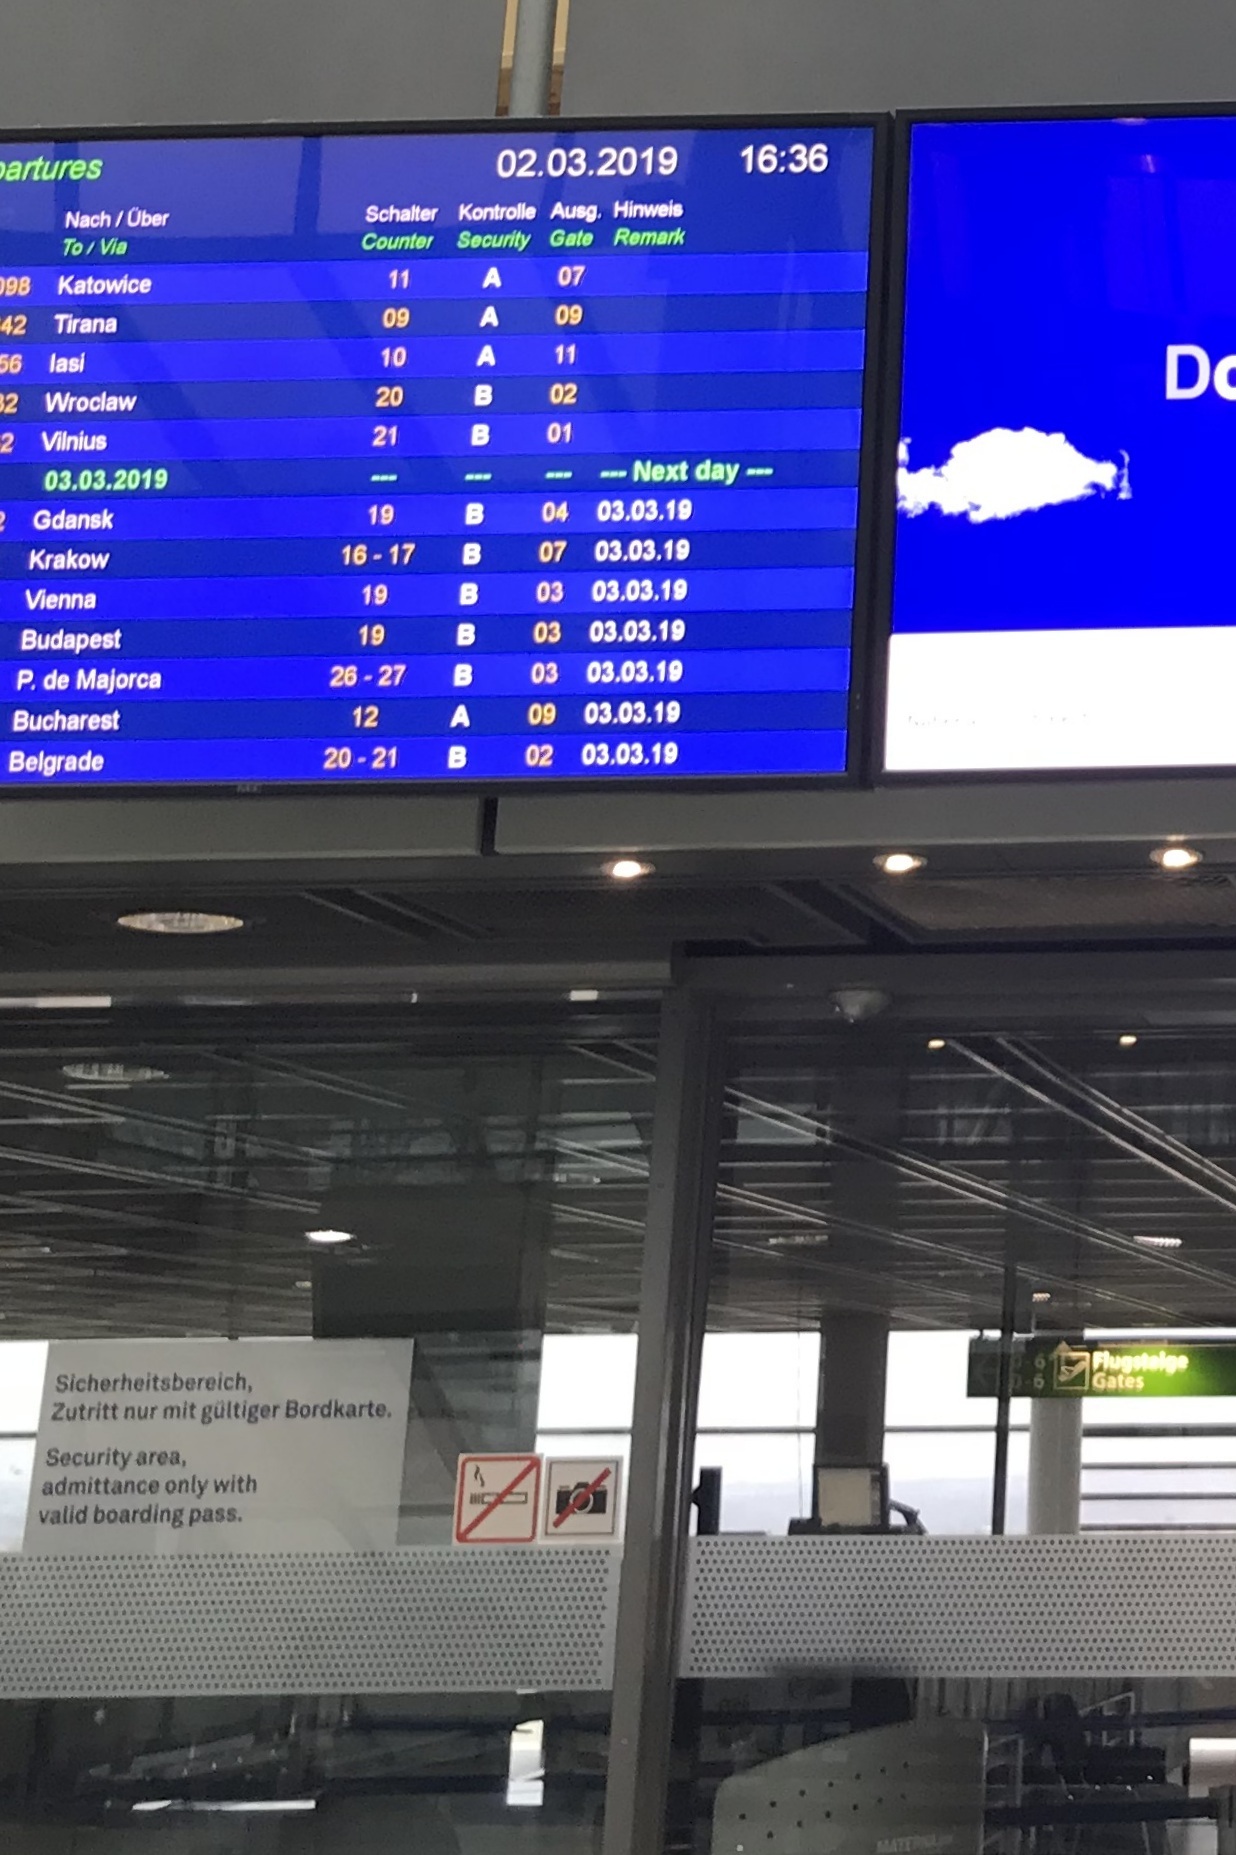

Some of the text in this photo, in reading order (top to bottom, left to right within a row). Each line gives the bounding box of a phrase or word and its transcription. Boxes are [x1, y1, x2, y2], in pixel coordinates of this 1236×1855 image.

[497, 146, 677, 178] 02.03.2019
[741, 144, 828, 173] 16:36
[66, 207, 169, 228] Nach Über
[365, 205, 438, 222] Schalter
[459, 203, 536, 220] Kontrolle
[550, 202, 601, 222] Ausg.
[614, 200, 683, 218] Hinweis
[64, 238, 127, 256] To Via
[362, 233, 434, 250] Counter
[457, 230, 531, 251] Security
[550, 229, 593, 247] Gate
[614, 228, 685, 246] Remark
[58, 274, 152, 295] Katowice
[390, 269, 409, 289] 11
[558, 266, 585, 286] 07
[54, 314, 117, 334] Tirana
[383, 308, 409, 328] 09
[480, 306, 498, 327] A
[555, 305, 582, 325] 09
[50, 352, 85, 373] Iasi
[382, 347, 406, 367] 10
[556, 344, 575, 364] 11
[46, 391, 137, 412] Wroclaw
[376, 386, 403, 407] 20
[550, 383, 577, 404] 02
[42, 431, 107, 451] Vilnius
[373, 425, 397, 446] 21
[547, 422, 571, 443] 01
[44, 469, 167, 491] 03.03.2019
[633, 459, 739, 485] Next day
[33, 509, 113, 530] Gdansk
[369, 504, 394, 525] 19
[542, 502, 568, 522] 04
[597, 499, 692, 521] 03.03.19
[29, 549, 110, 570] Krakow
[342, 543, 415, 565] 16 17
[539, 541, 567, 562] 07
[595, 539, 690, 561] 03.03.19
[26, 589, 96, 610] Vienna
[363, 584, 387, 605] 19
[536, 581, 563, 602] 03
[592, 579, 687, 602] 03.03.19
[360, 624, 384, 645] 19
[534, 621, 561, 643] 03
[590, 619, 685, 642] 03.03.19
[21, 629, 122, 654] Budapest
[17, 668, 161, 694] P. de Majorca
[330, 664, 406, 687] 26 27
[531, 662, 558, 684] 03
[587, 660, 682, 683] 03.03.19
[13, 710, 120, 731] Bucharest
[353, 706, 378, 727] 12
[528, 703, 556, 725] 09
[584, 701, 680, 724] 03.03.19
[9, 750, 104, 776] Belgrade
[323, 747, 396, 769] 20 21
[525, 744, 553, 766] 02
[582, 742, 678, 765] 03.03.19
[56, 1371, 252, 1393] Sicherheitsbereich,
[1092, 1372, 1145, 1391] Gates
[51, 1399, 391, 1425] Zutritt nur mit gültiger Bordkarte.
[46, 1447, 186, 1471] Security area,
[42, 1474, 257, 1499] admittance only with
[39, 1504, 242, 1529] valid boarding pass.
